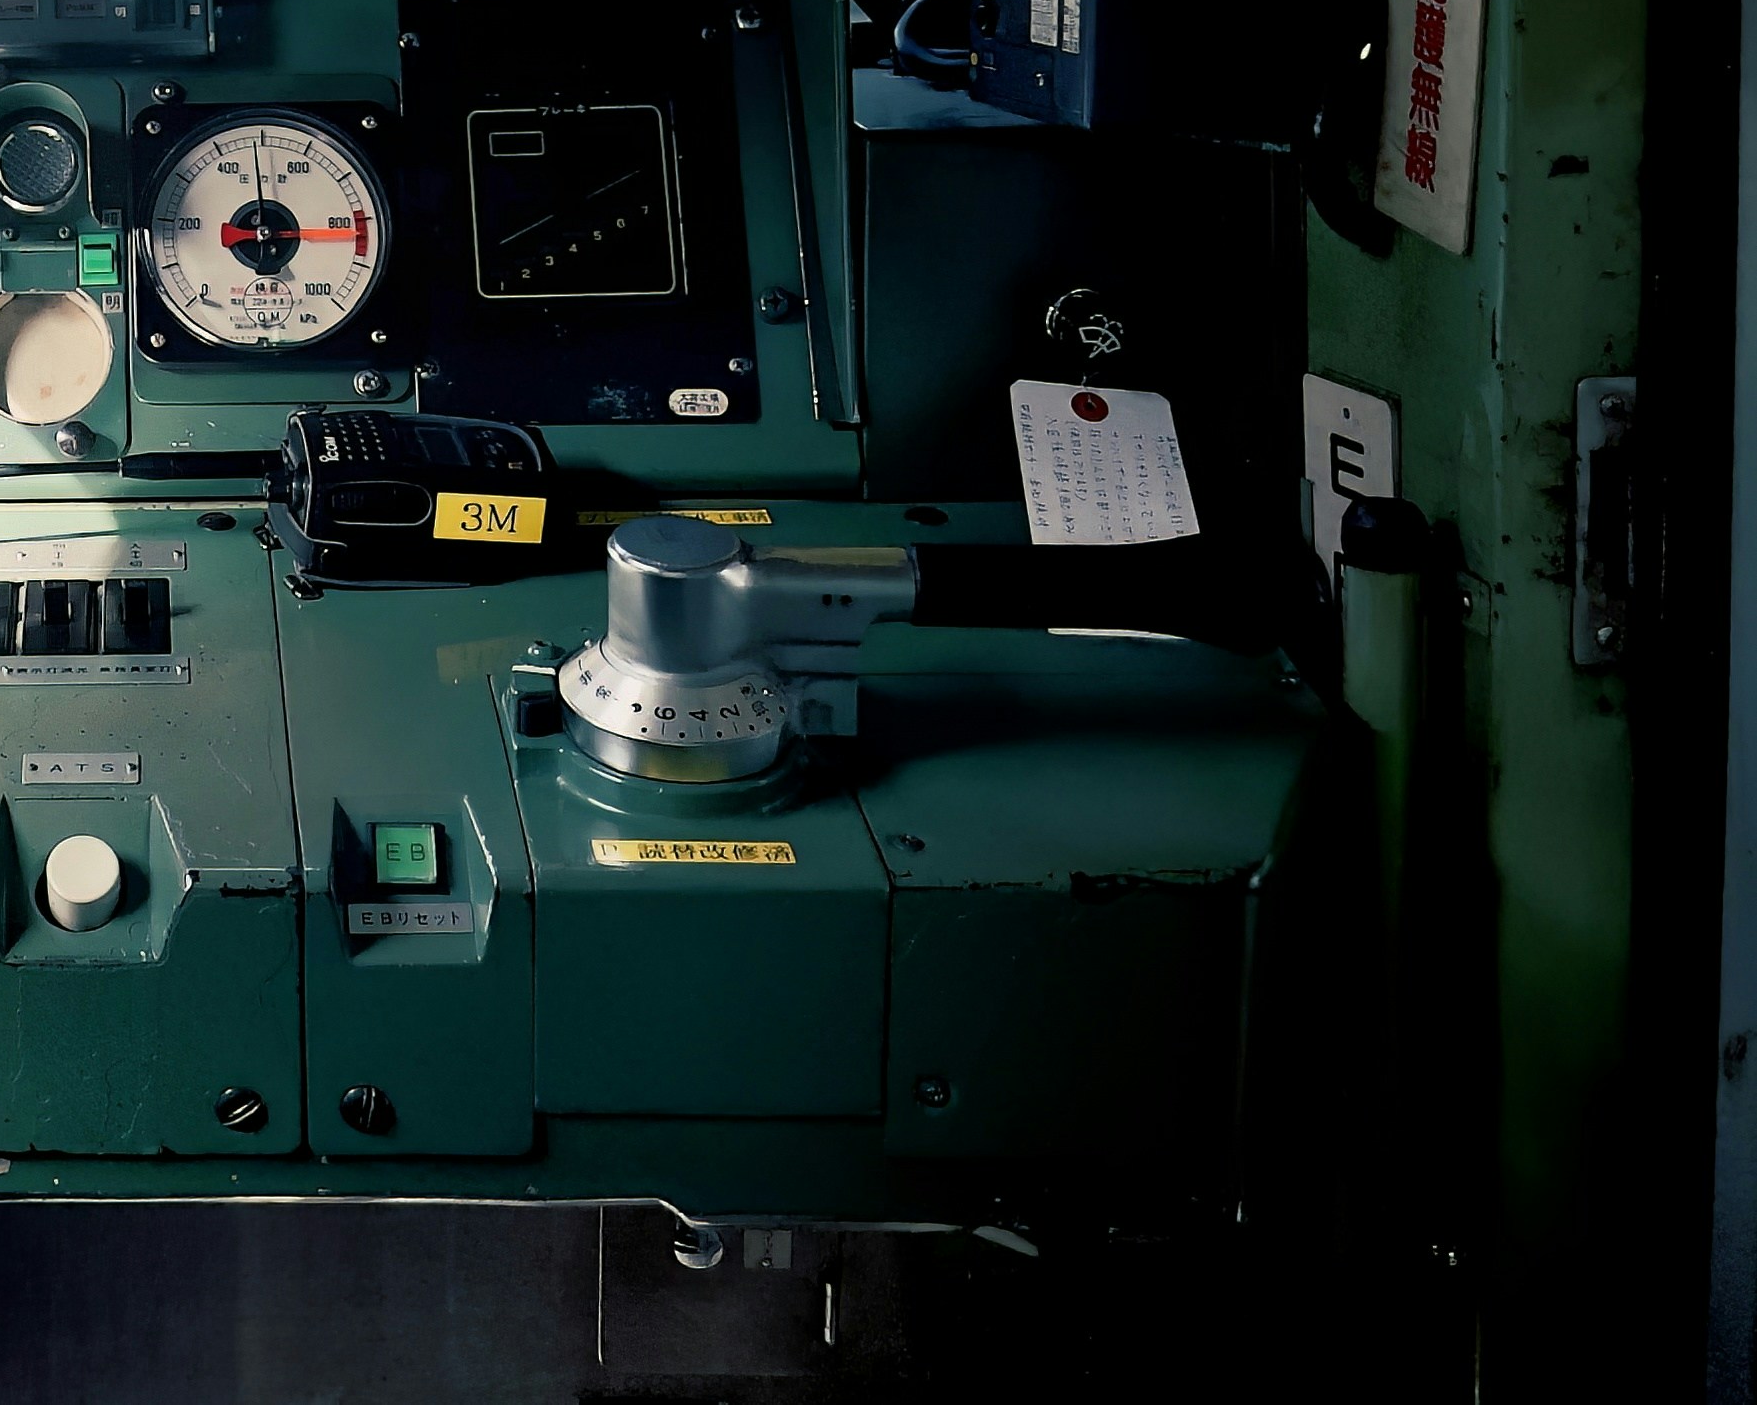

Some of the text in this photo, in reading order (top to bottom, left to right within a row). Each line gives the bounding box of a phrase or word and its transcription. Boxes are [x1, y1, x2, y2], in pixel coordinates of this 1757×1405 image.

[217, 162, 239, 174] 400
[287, 161, 310, 174] 600
[178, 217, 200, 230] 200
[328, 217, 351, 229] 800
[593, 230, 602, 241] 5
[568, 243, 579, 253] 4
[545, 256, 554, 267] 3
[521, 268, 531, 279] 2
[201, 283, 209, 296] 0
[304, 283, 331, 295] 1000
[105, 295, 121, 310] 明
[460, 503, 519, 533] 3M
[654, 703, 741, 723] 6 4 2
[49, 762, 115, 773] ATS
[386, 842, 425, 862] EB
[361, 911, 460, 926] EBリセット
